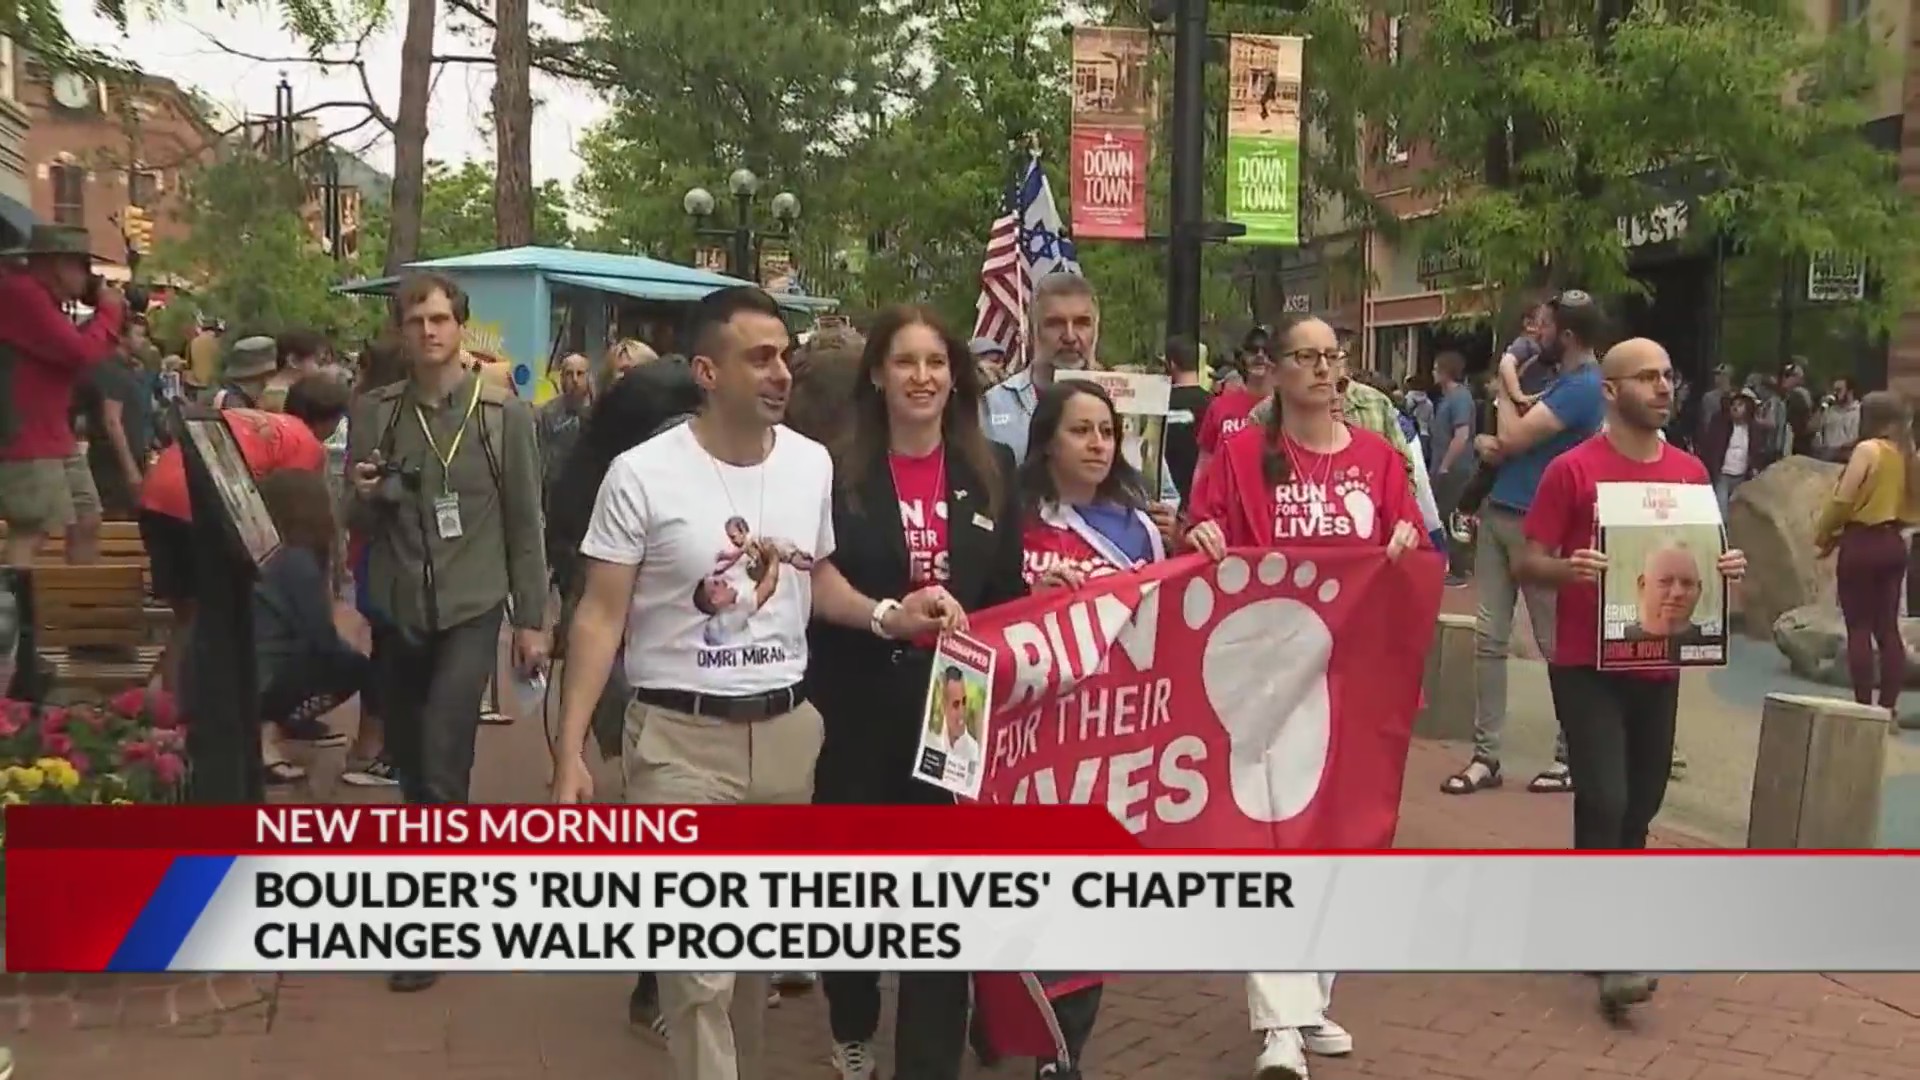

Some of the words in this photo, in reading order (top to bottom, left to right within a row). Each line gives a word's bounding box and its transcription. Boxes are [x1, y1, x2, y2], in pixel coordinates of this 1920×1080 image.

[1084, 150, 1133, 176] DOWN
[1239, 157, 1286, 183] DOWN
[1086, 177, 1132, 204] TOWN
[1241, 183, 1286, 209] TOWN
[1222, 417, 1248, 433] RU
[1275, 484, 1326, 503] RUN
[1275, 503, 1298, 516] FOR
[1302, 503, 1337, 516] TIR
[905, 529, 938, 548] EIR
[1275, 515, 1351, 538] LIVES
[697, 649, 737, 668] OMRI
[1000, 580, 1161, 714] RUN
[991, 711, 1042, 779] FOR
[1057, 678, 1171, 745] THEIR
